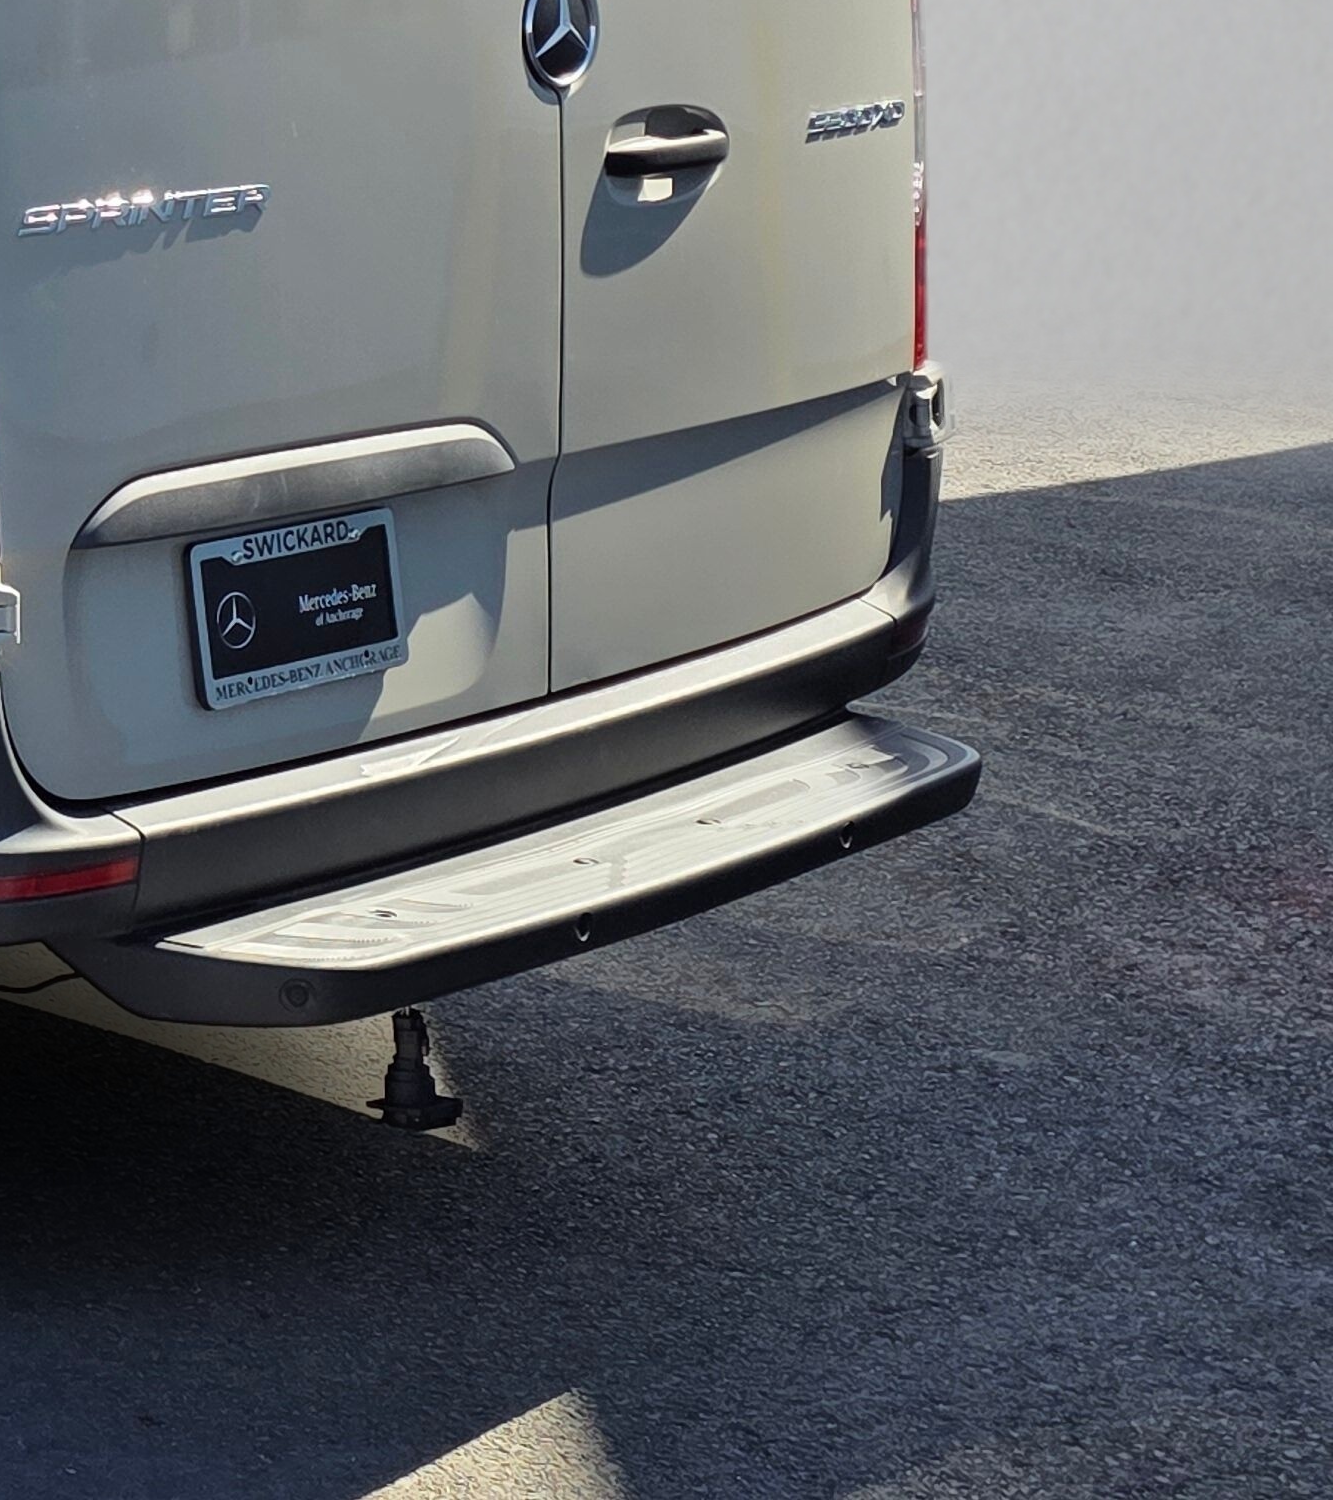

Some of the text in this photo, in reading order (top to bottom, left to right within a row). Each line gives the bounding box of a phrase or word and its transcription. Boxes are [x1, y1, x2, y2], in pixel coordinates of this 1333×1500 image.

[17, 183, 271, 238] SPRINTER
[242, 519, 349, 560] SWICKARD
[298, 583, 377, 614] Mercedes-Benz
